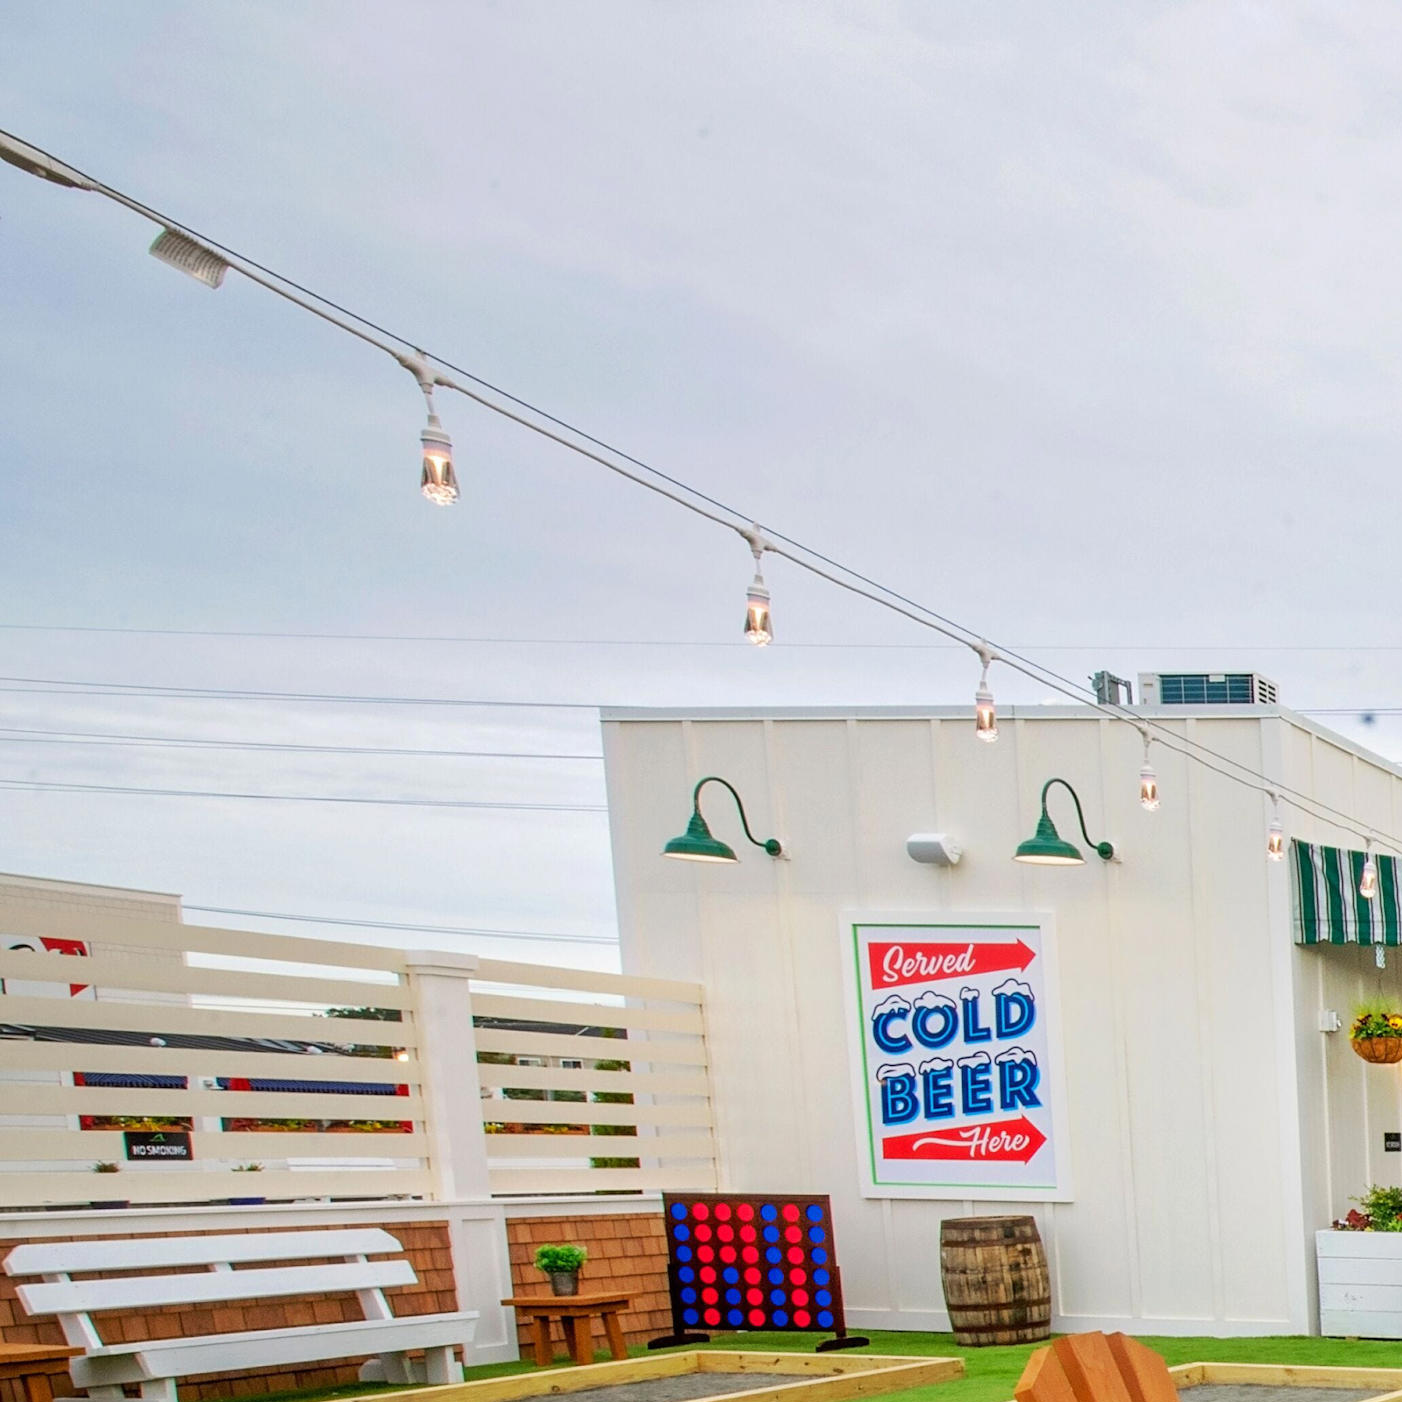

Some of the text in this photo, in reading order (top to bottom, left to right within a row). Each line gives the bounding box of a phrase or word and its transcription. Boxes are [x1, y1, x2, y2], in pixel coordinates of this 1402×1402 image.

[883, 943, 976, 983] Served
[872, 979, 1037, 1055] COLD
[878, 1048, 1043, 1125] BEER
[132, 1145, 187, 1156] NO SMOKING
[913, 1127, 1030, 1157] Here
